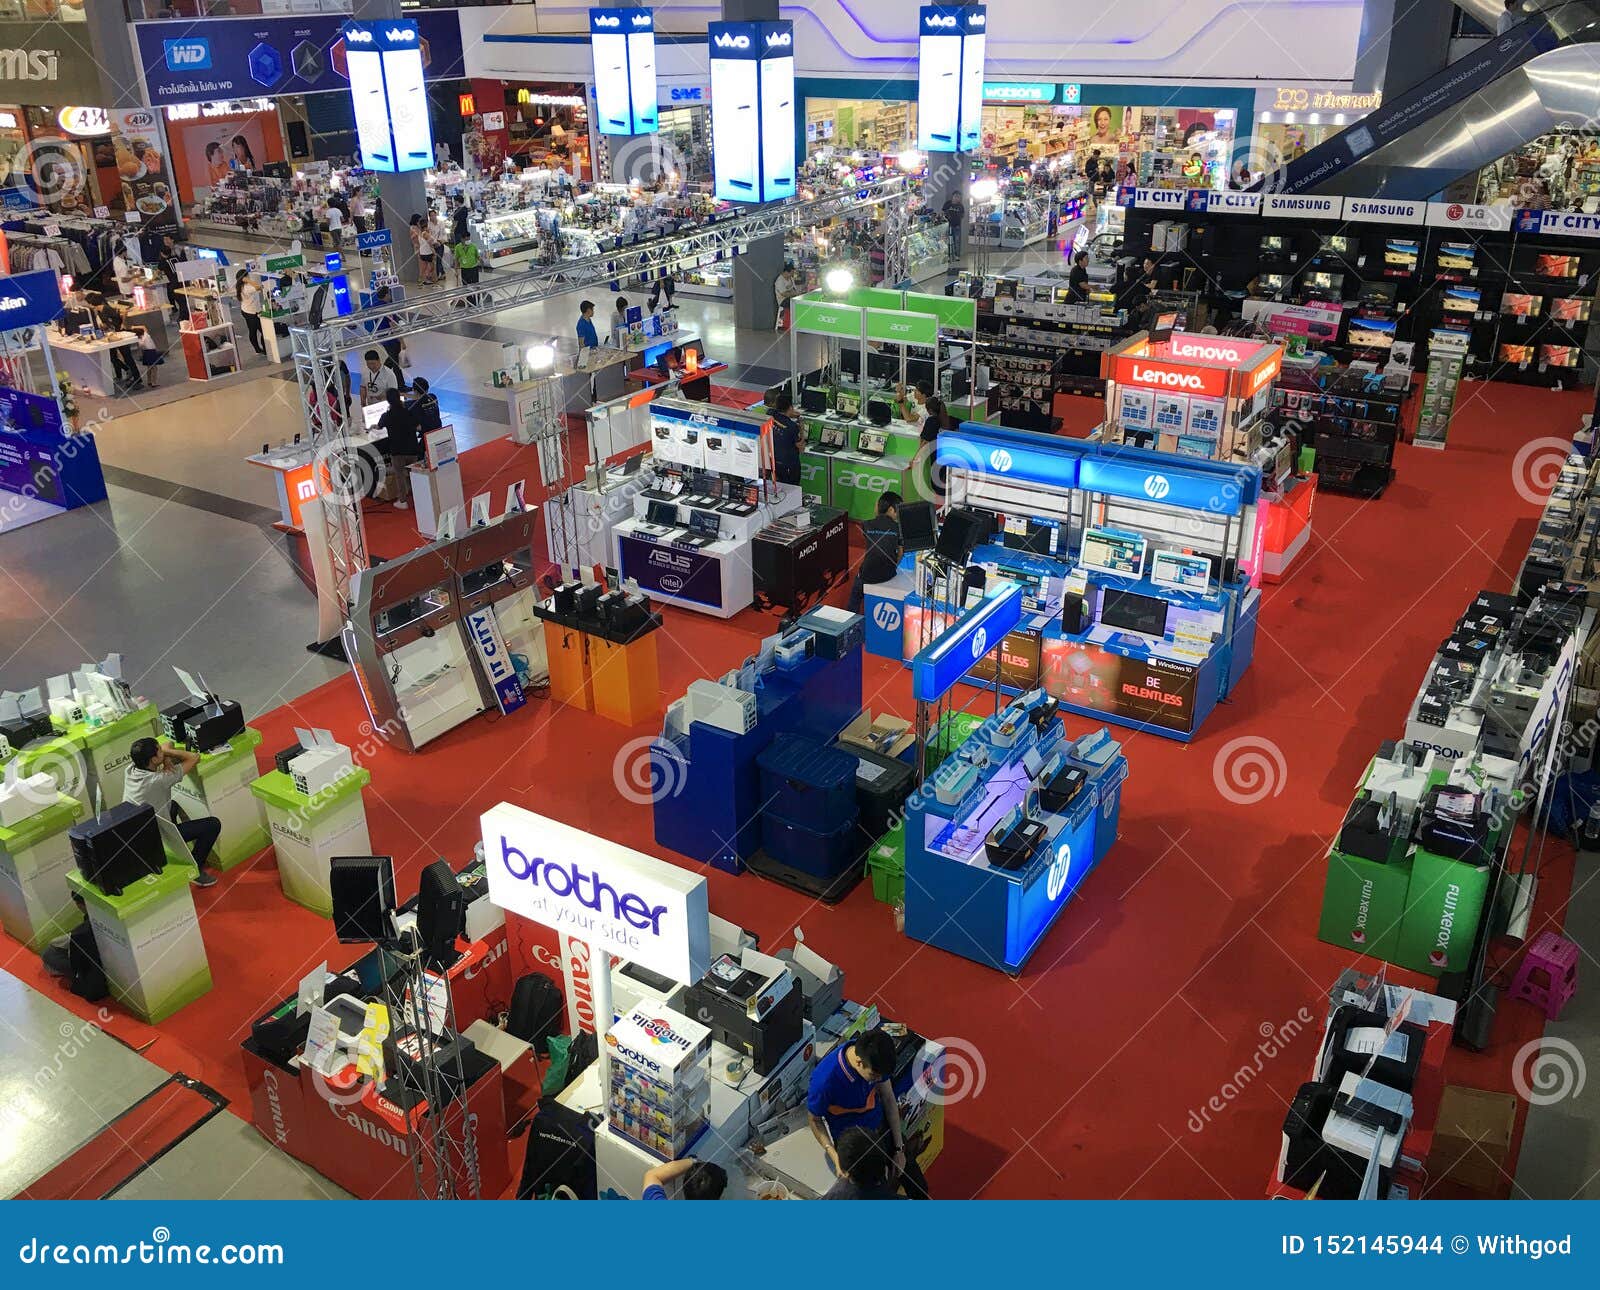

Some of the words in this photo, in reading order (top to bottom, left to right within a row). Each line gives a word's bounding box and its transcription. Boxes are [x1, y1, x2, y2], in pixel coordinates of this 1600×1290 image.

[595, 15, 620, 26] vivo
[631, 14, 651, 26] vivo
[925, 14, 956, 26] vivo
[969, 13, 985, 26] vivo
[346, 29, 372, 42] vivo
[386, 28, 415, 41] vivo
[714, 32, 750, 48] vivo
[766, 32, 791, 47] vivo
[173, 45, 205, 64] WD
[985, 86, 1041, 99] watsons
[1137, 191, 1149, 202] IT
[1152, 192, 1183, 204] CITY
[1209, 194, 1222, 206] IT
[1226, 195, 1257, 207] CITY
[1271, 198, 1331, 210] SAMSUNG
[1351, 203, 1414, 217] SAMSUNG
[1466, 208, 1485, 219] LG
[1543, 214, 1559, 227] IT
[362, 234, 386, 244] vivo
[818, 314, 838, 324] acer
[890, 322, 912, 333] acer
[689, 413, 719, 426] ASUS
[990, 449, 1013, 473] hp
[837, 469, 899, 494] acer
[1144, 474, 1170, 499] hp
[648, 549, 691, 569] ASUS
[873, 602, 901, 632] hp
[472, 616, 497, 657] CITY
[972, 627, 987, 659] hp
[489, 661, 506, 679] IT
[1157, 660, 1185, 672] Windows
[1146, 676, 1161, 689] BE
[1122, 684, 1183, 707] RELENTLESS
[1047, 844, 1071, 901] hp
[500, 835, 668, 937] brother
[532, 897, 548, 910] at
[555, 904, 595, 932] your
[601, 920, 640, 951] side
[631, 1014, 692, 1051] innobella
[263, 1069, 289, 1144] Canon
[378, 1097, 405, 1117] Canon
[328, 1097, 408, 1156] Canon
